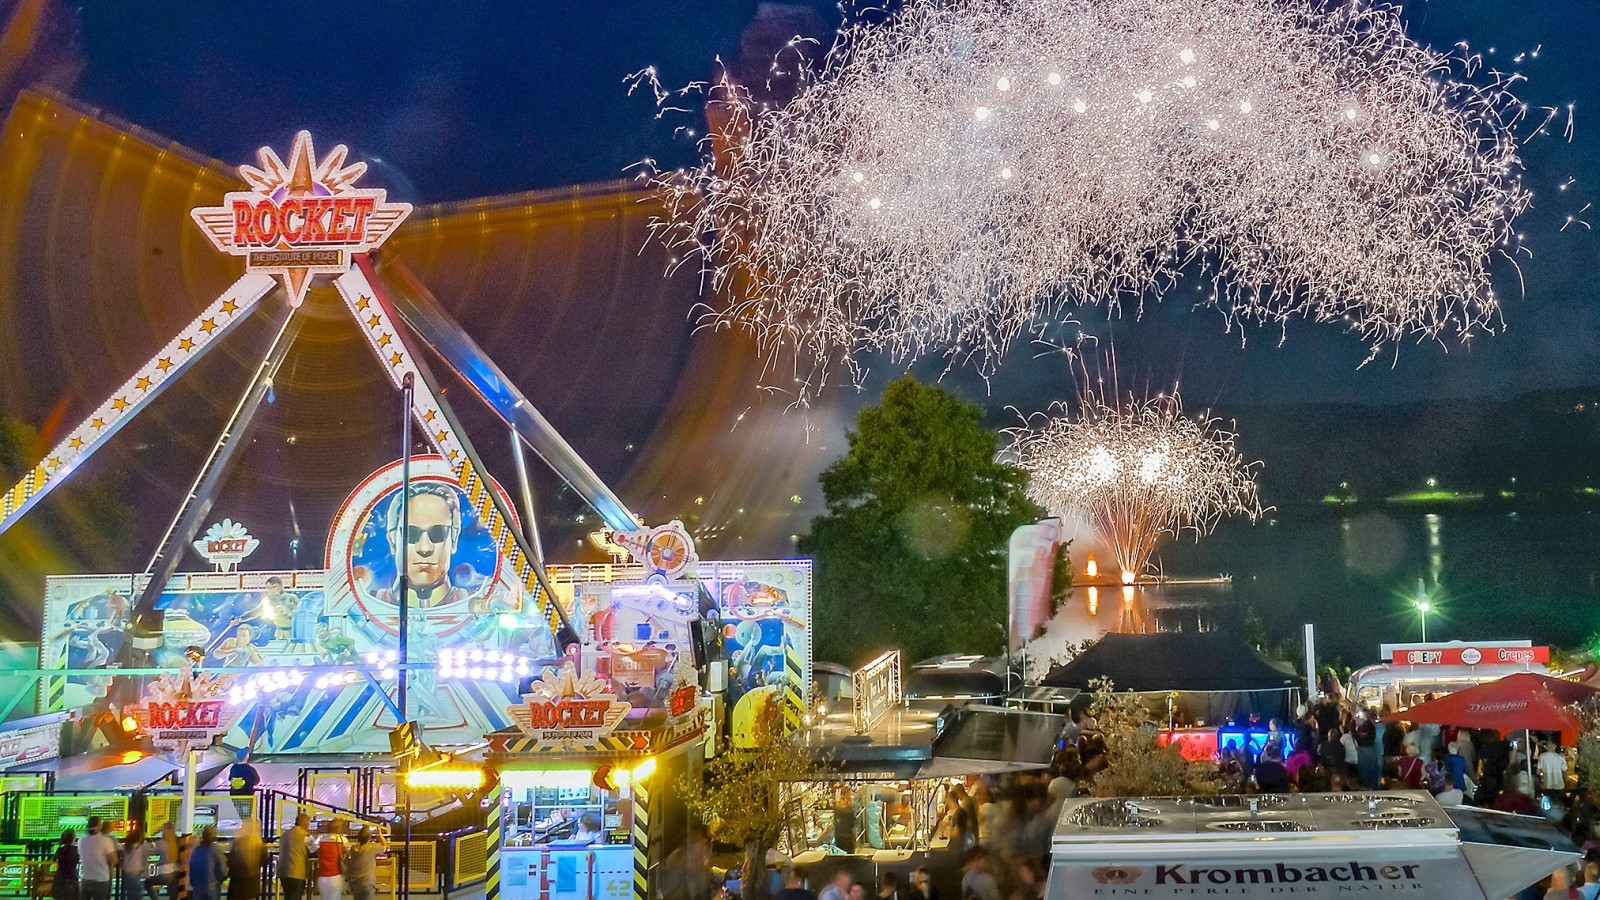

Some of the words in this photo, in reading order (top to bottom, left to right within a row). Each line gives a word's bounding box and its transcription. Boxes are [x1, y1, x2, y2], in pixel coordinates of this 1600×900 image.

[233, 197, 375, 246] ROCKET
[313, 252, 336, 260] POWER
[207, 539, 247, 553] ROCKET
[1408, 651, 1442, 664] CREPY
[1499, 648, 1534, 662] Crepes
[148, 701, 224, 728] ROCKET
[530, 701, 610, 728] ROCKET
[1156, 861, 1420, 885] Krombacher
[1339, 883, 1424, 892] NATUR
